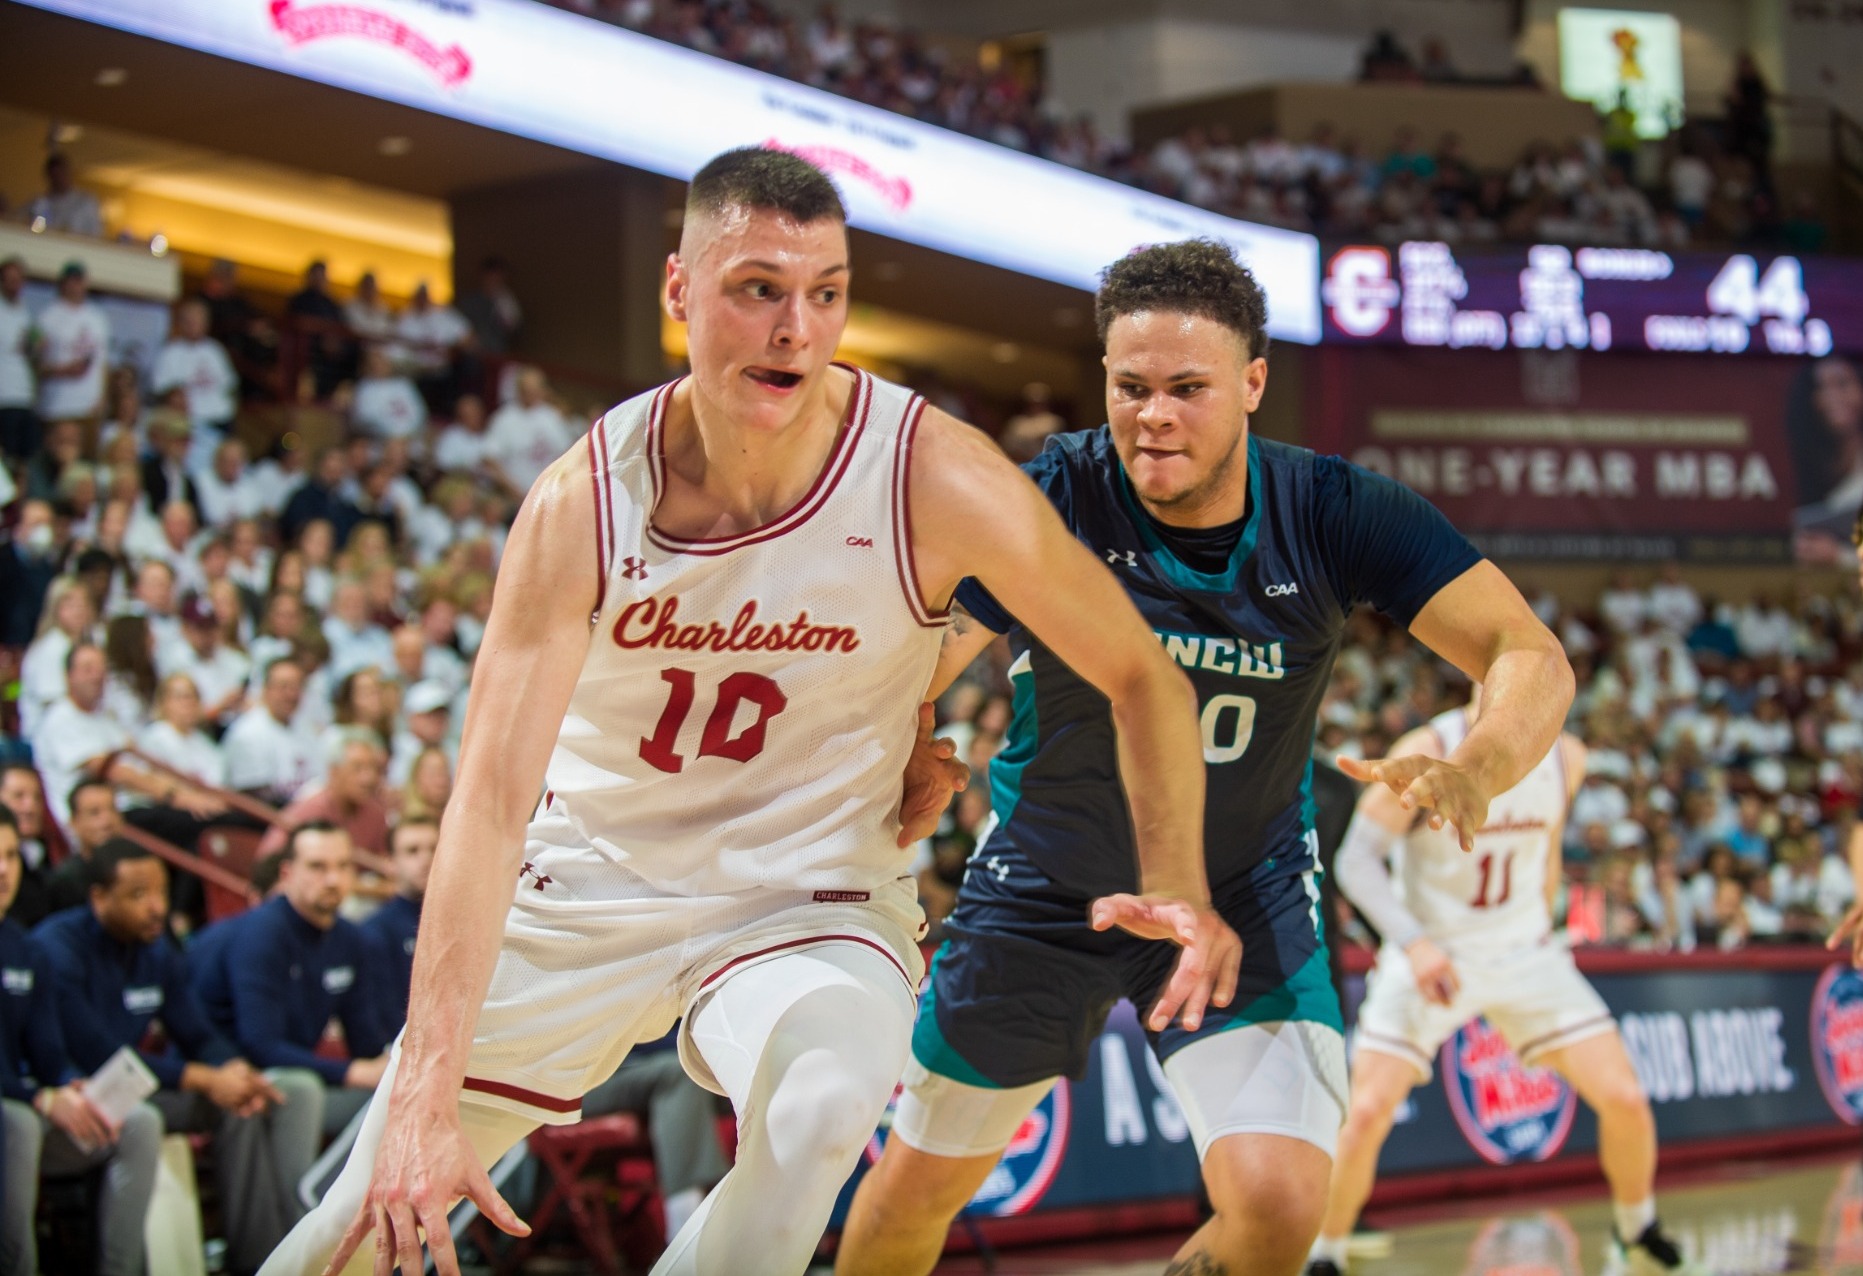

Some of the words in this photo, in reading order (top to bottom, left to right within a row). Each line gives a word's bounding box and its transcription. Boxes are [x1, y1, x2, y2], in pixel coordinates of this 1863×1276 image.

[1706, 253, 1810, 325] 44
[1654, 452, 1779, 500] MBA
[845, 535, 873, 548] CAA
[1265, 582, 1298, 597] CAA
[611, 594, 860, 654] Charleston
[1154, 631, 1286, 681] NCW
[638, 667, 788, 774] 10
[816, 891, 867, 901] CHARLESTON
[1469, 851, 1519, 909] 11
